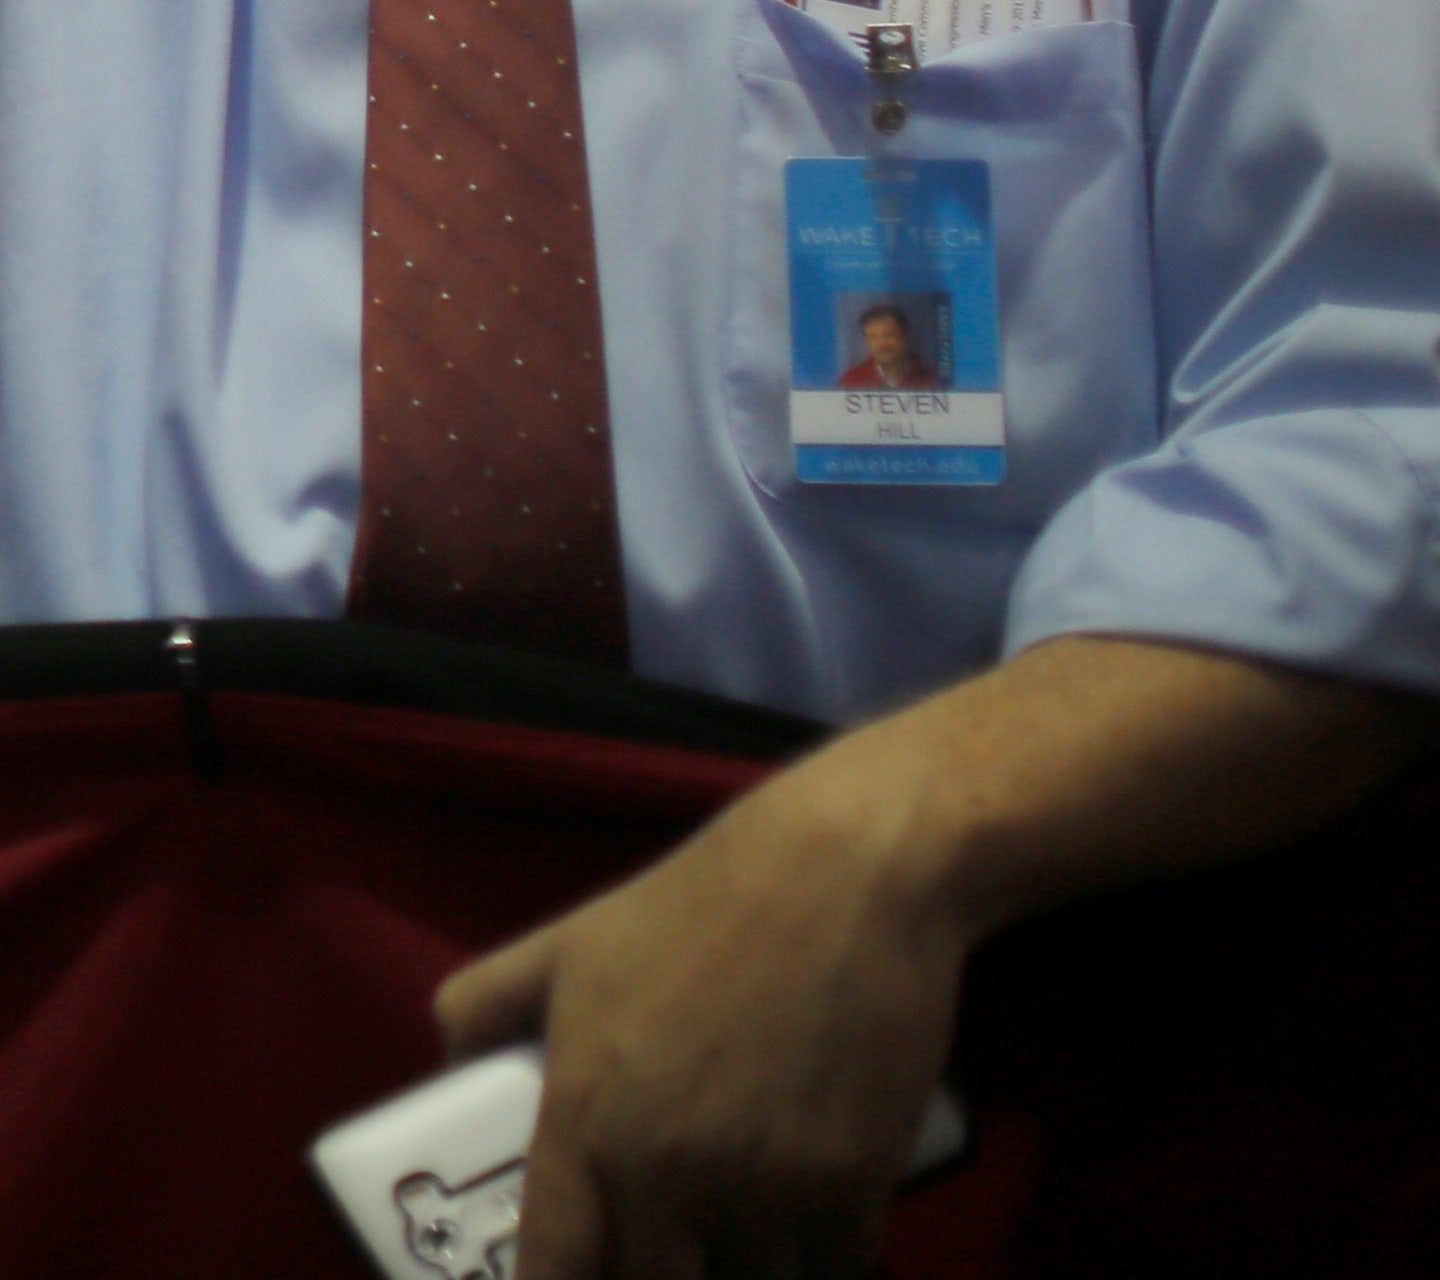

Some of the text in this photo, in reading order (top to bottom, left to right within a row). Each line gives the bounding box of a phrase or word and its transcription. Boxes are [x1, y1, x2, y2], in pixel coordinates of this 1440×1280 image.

[797, 225, 878, 247] WAKE
[845, 393, 950, 415] STEVEN
[876, 422, 922, 440] HILL
